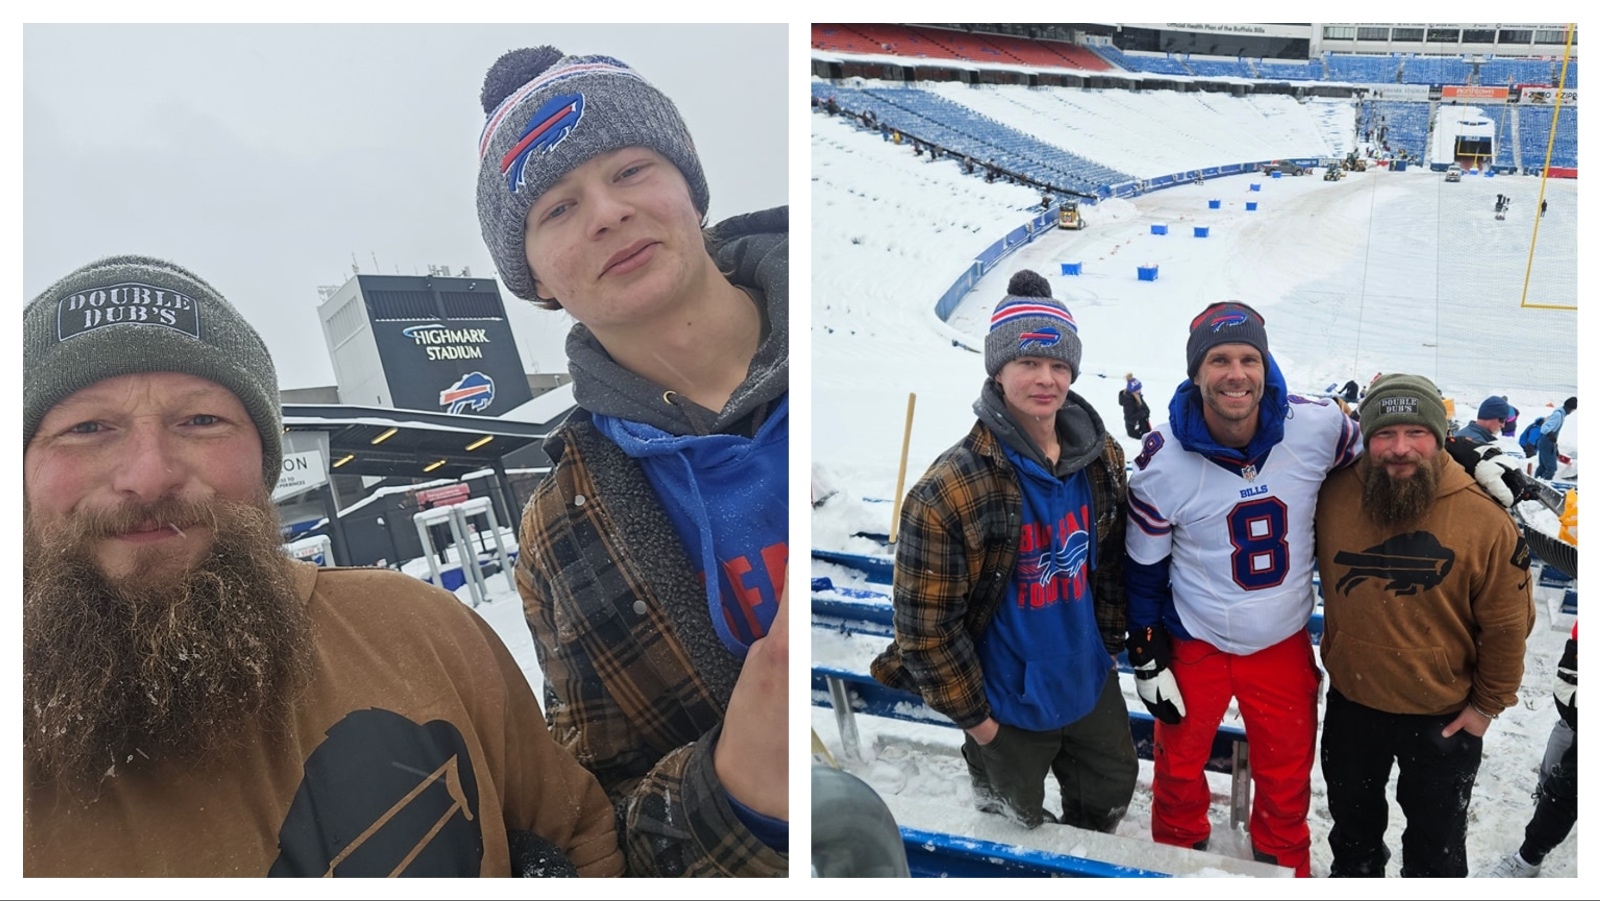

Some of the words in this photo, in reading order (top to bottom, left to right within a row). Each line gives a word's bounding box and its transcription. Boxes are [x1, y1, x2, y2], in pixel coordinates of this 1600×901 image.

[68, 287, 190, 311] DOUBLE
[84, 306, 177, 328] DUB'S
[413, 329, 490, 345] HIGHMARK
[426, 346, 482, 360] STADIUM
[1381, 398, 1417, 407] DOUBLE
[1386, 405, 1413, 413] DUB'S
[1239, 484, 1268, 498] BILLS
[1226, 495, 1291, 591] 8
